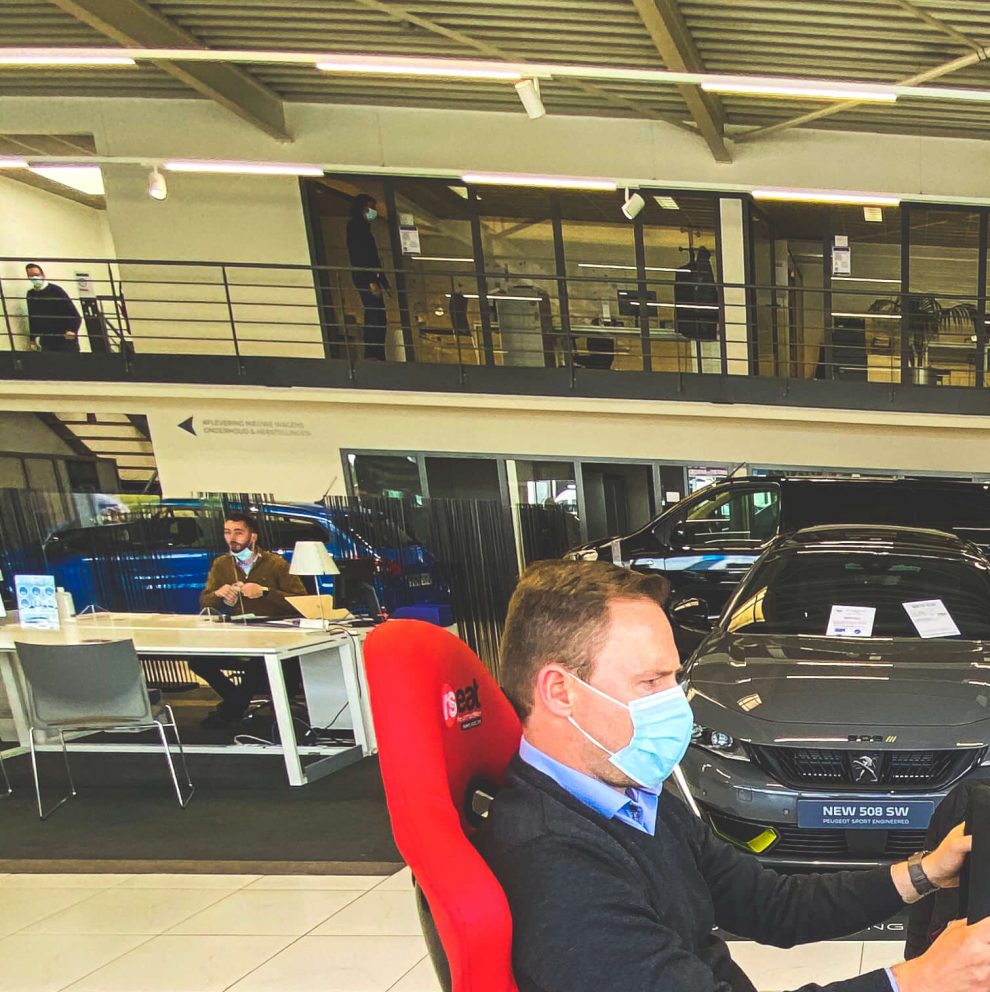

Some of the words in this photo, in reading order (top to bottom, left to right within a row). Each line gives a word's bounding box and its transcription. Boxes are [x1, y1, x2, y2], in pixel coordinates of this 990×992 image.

[823, 806, 857, 816] NEW
[860, 806, 883, 817] 508
[886, 806, 910, 817] SW
